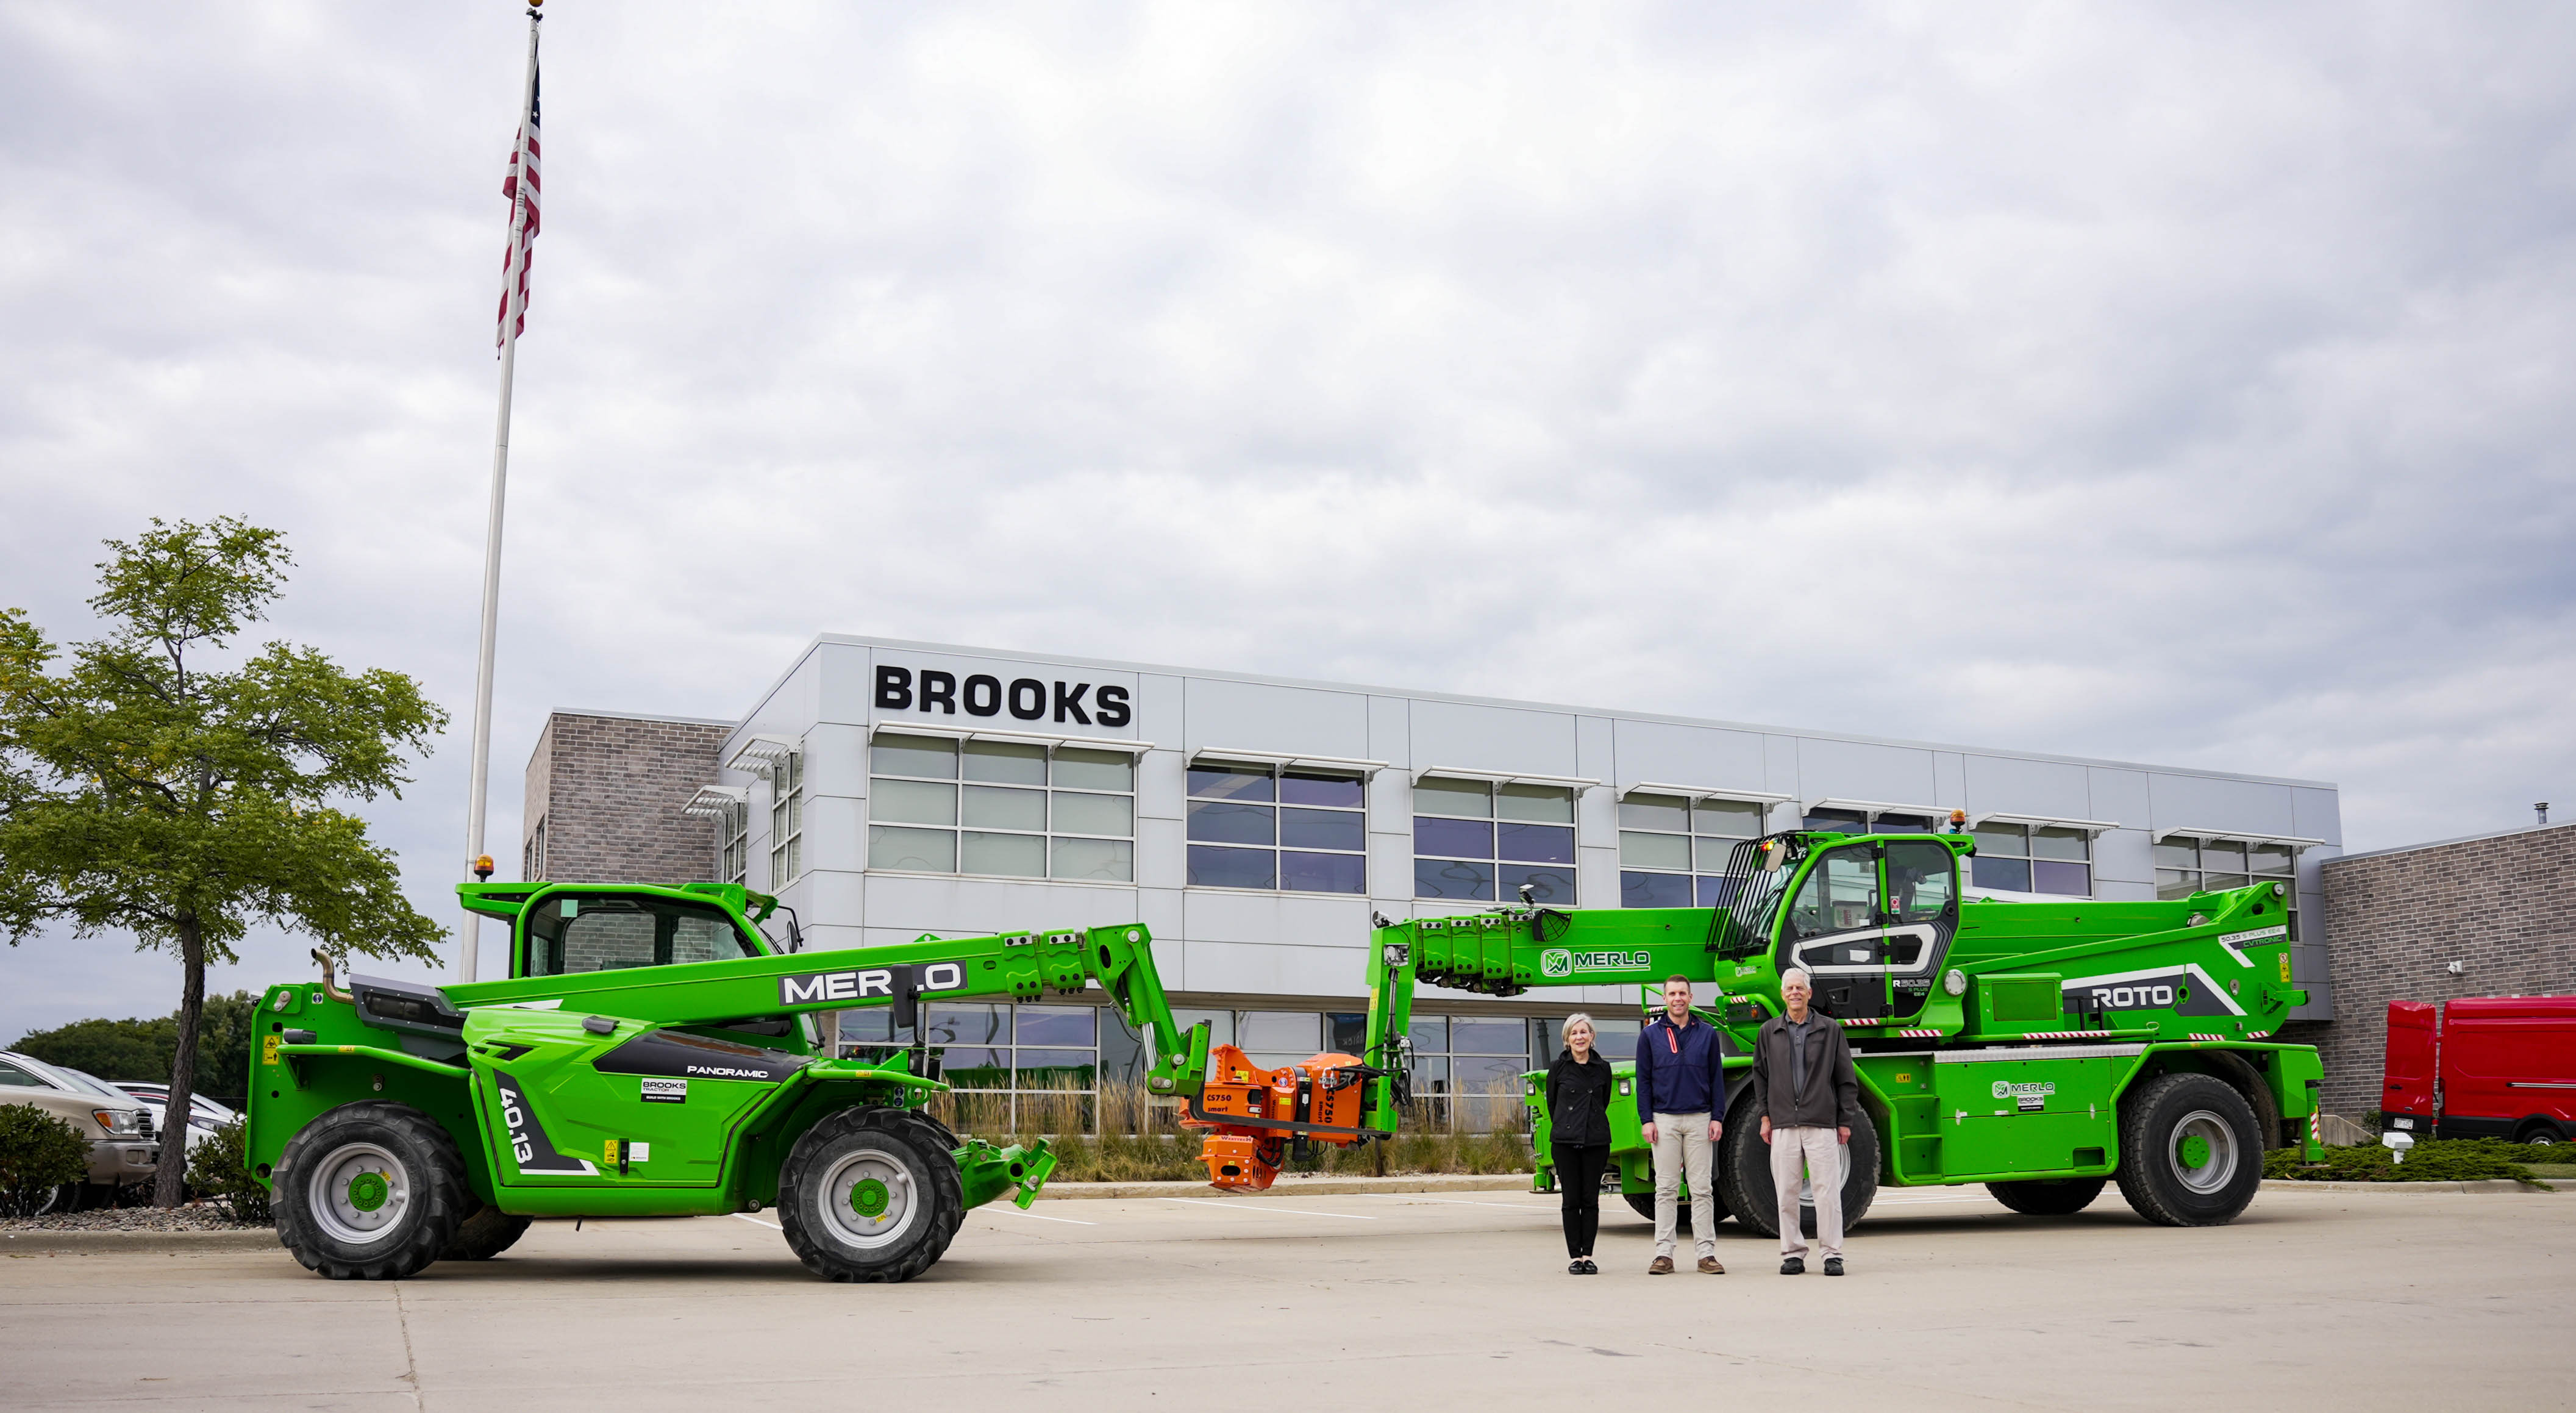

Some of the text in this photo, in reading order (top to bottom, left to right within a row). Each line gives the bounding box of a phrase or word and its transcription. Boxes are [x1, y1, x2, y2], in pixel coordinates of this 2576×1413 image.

[875, 665, 1131, 728] BROOKS
[2244, 935, 2283, 947] CVTRONIC
[1574, 951, 1650, 967] MERLO
[783, 963, 961, 1004] MERO
[2092, 986, 2173, 1008] ROTO
[687, 1065, 769, 1078] PANORAMIC
[2011, 1082, 2054, 1092] MERLO
[1324, 1089, 1335, 1123] CS750
[499, 1088, 533, 1164] 40.13
